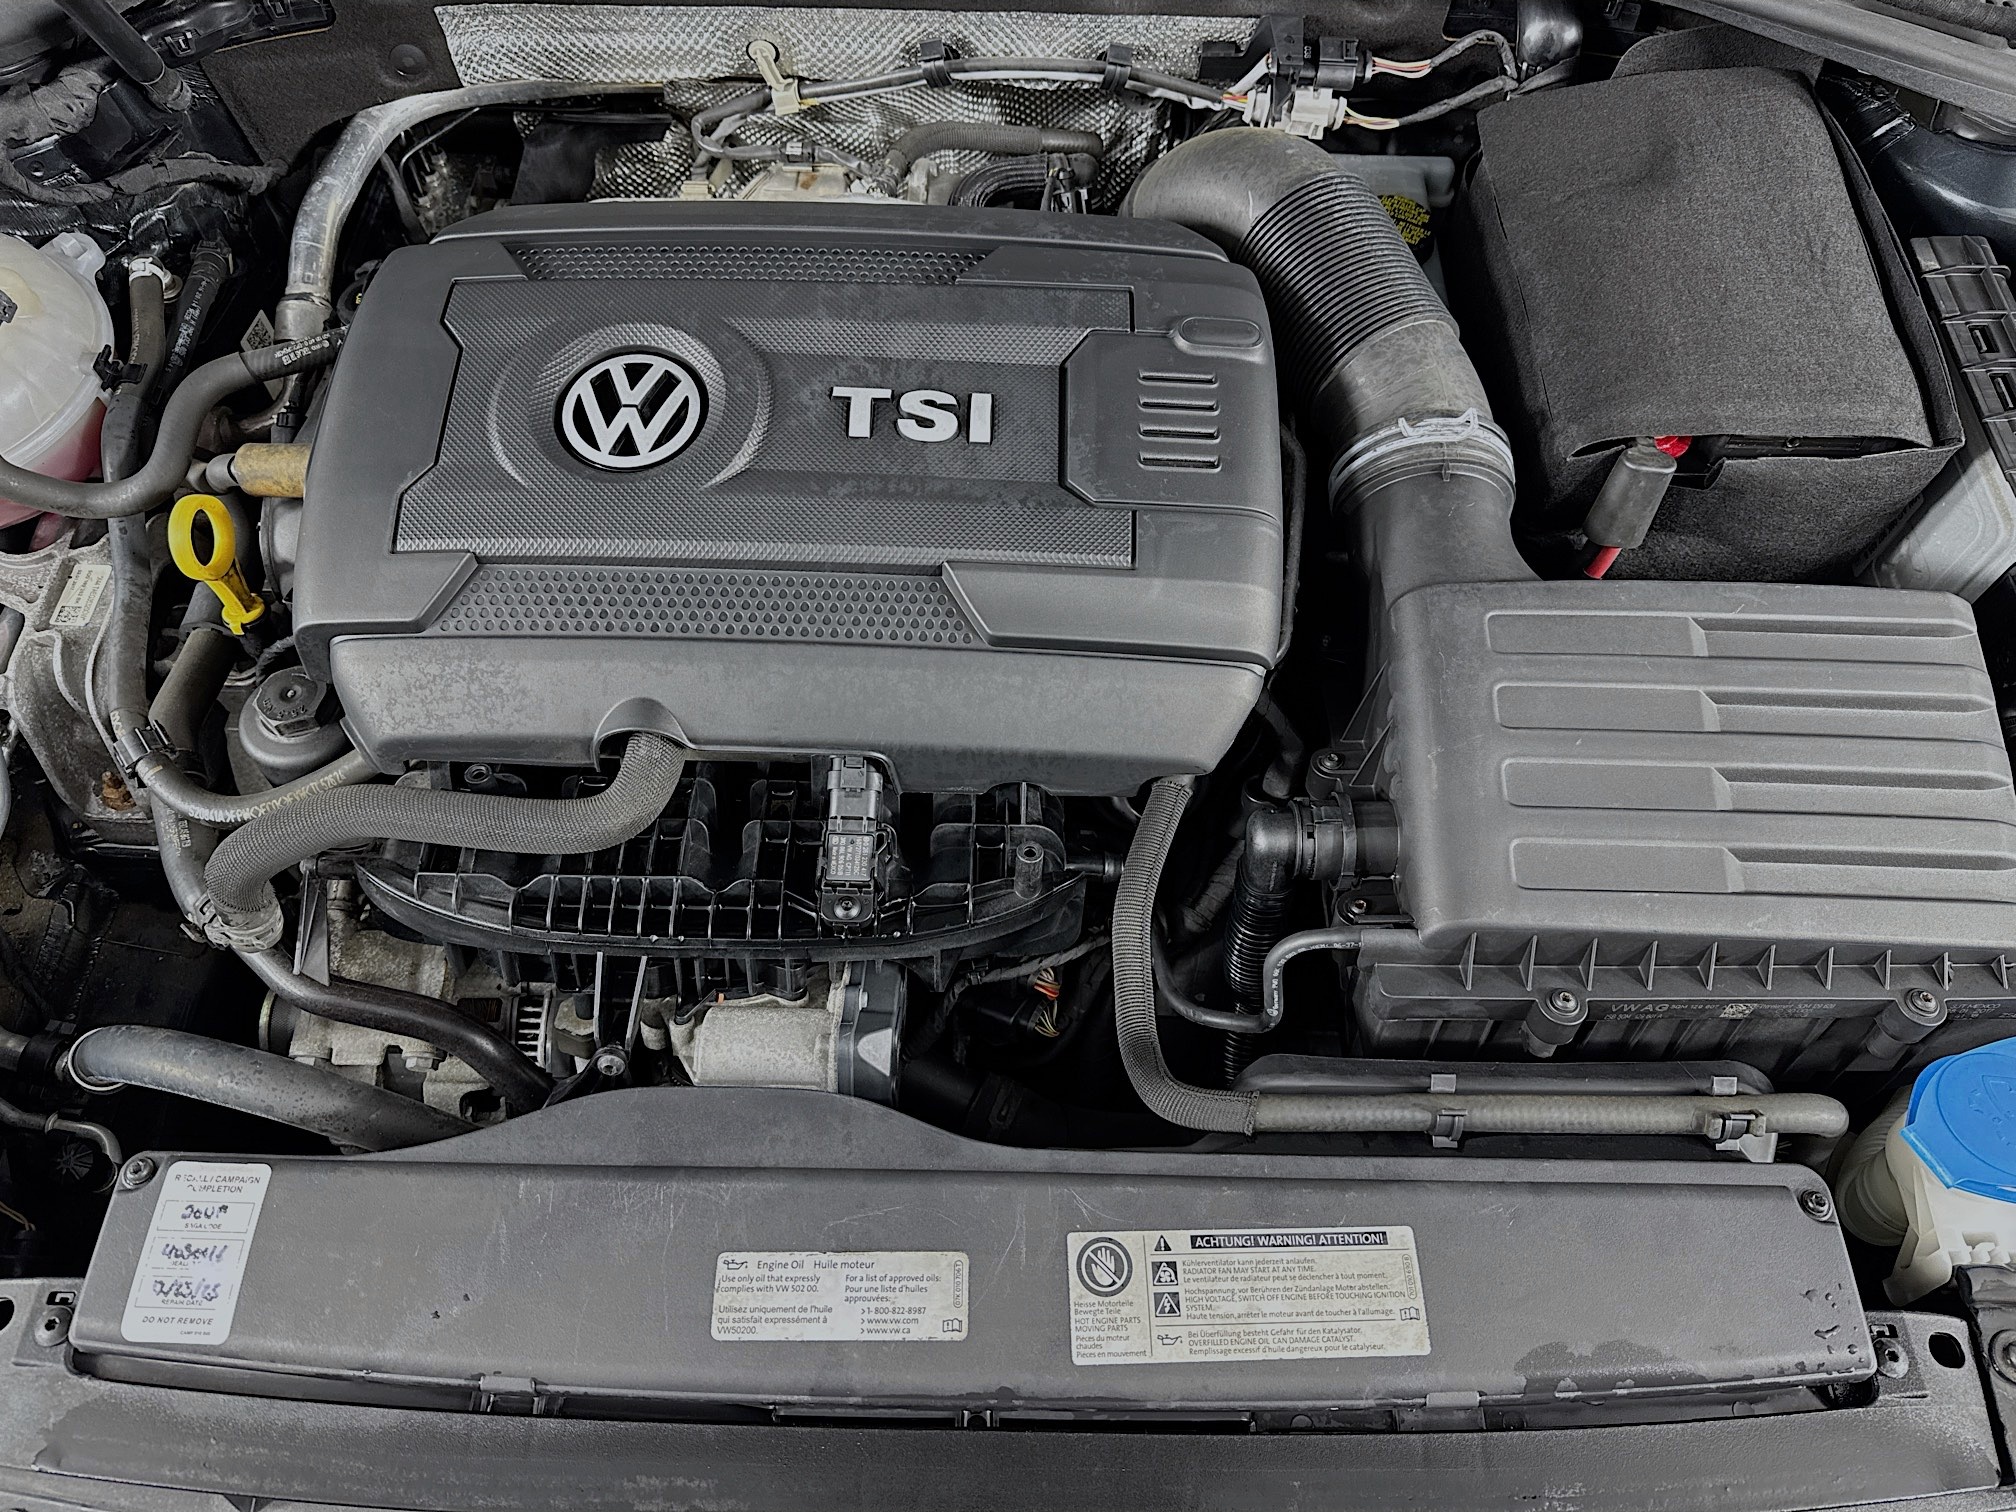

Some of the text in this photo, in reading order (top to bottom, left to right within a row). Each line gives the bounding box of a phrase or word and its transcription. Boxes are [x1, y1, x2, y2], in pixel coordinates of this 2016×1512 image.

[562, 354, 700, 468] VW
[830, 385, 993, 446] TSI
[1611, 1004, 1640, 1012] VW
[1640, 1004, 1669, 1012] AG
[215, 1175, 260, 1184] CAMPAIGN
[1195, 1233, 1384, 1248] ACHTUNG! WARNING! ATTENTION!
[757, 1260, 875, 1272] Engine Oil Huile moteur
[1255, 1258, 1284, 1267] jederzeit
[1234, 1266, 1249, 1274] MAY
[1250, 1266, 1270, 1274] START
[737, 1274, 754, 1284] only
[756, 1274, 766, 1282] oil
[767, 1274, 783, 1282] that
[784, 1274, 820, 1284] expressly
[846, 1274, 858, 1282] For
[866, 1274, 877, 1282] list
[878, 1274, 888, 1282] of
[888, 1274, 924, 1284] approved
[926, 1274, 942, 1282] oils:
[1240, 1274, 1271, 1282] radiateur
[1272, 1274, 1288, 1283] peut
[1340, 1272, 1355, 1280] tout
[1356, 1272, 1387, 1280] moment.
[720, 1285, 754, 1294] complies
[757, 1284, 774, 1292] with
[791, 1284, 804, 1292] 502
[806, 1284, 819, 1292] 00.
[898, 1284, 928, 1292] d'huiles
[1184, 1287, 1237, 1296] Hochspannung,
[1250, 1286, 1280, 1294] Berühren
[1294, 1284, 1334, 1294] Zündanlage
[1336, 1284, 1356, 1292] Motor
[1357, 1283, 1390, 1291] abstellen.
[844, 1294, 890, 1304] approuvées:
[1238, 1294, 1265, 1302] SWITCH
[1308, 1292, 1334, 1300] BEFORE
[1335, 1292, 1372, 1300] TOUCHING
[1074, 1300, 1096, 1308] Heisse
[718, 1305, 832, 1314] Utilisez uniquement de l'huile
[1074, 1308, 1104, 1316] Bewegte
[1186, 1312, 1208, 1320] Haute
[1209, 1312, 1237, 1320] tension,
[1269, 1310, 1294, 1318] moteur
[1325, 1308, 1352, 1316] toucher
[1358, 1308, 1395, 1316] l'allumage.
[157, 1316, 176, 1324] NOT
[177, 1318, 214, 1326] REMOVE
[718, 1316, 828, 1325] qui satisfait expressément à
[1120, 1316, 1141, 1324] PARTS
[1107, 1324, 1128, 1332] PARTS
[1200, 1329, 1242, 1339] Überfüllung
[1242, 1329, 1270, 1337] besteht
[1270, 1328, 1294, 1336] Gefahr
[1296, 1328, 1306, 1336] für
[1322, 1327, 1363, 1336] Katalysator.
[1096, 1334, 1104, 1342] du
[1230, 1338, 1258, 1346] ENGINE
[1289, 1336, 1320, 1344] DAMAGE
[1076, 1342, 1102, 1350] chaudes
[1189, 1348, 1232, 1356] Remplissage
[1233, 1346, 1260, 1354] excessif
[1286, 1346, 1322, 1354] dangereux
[1324, 1344, 1340, 1352] pour
[1349, 1342, 1386, 1352] catalyseur.
[1106, 1350, 1147, 1358] mouvement
